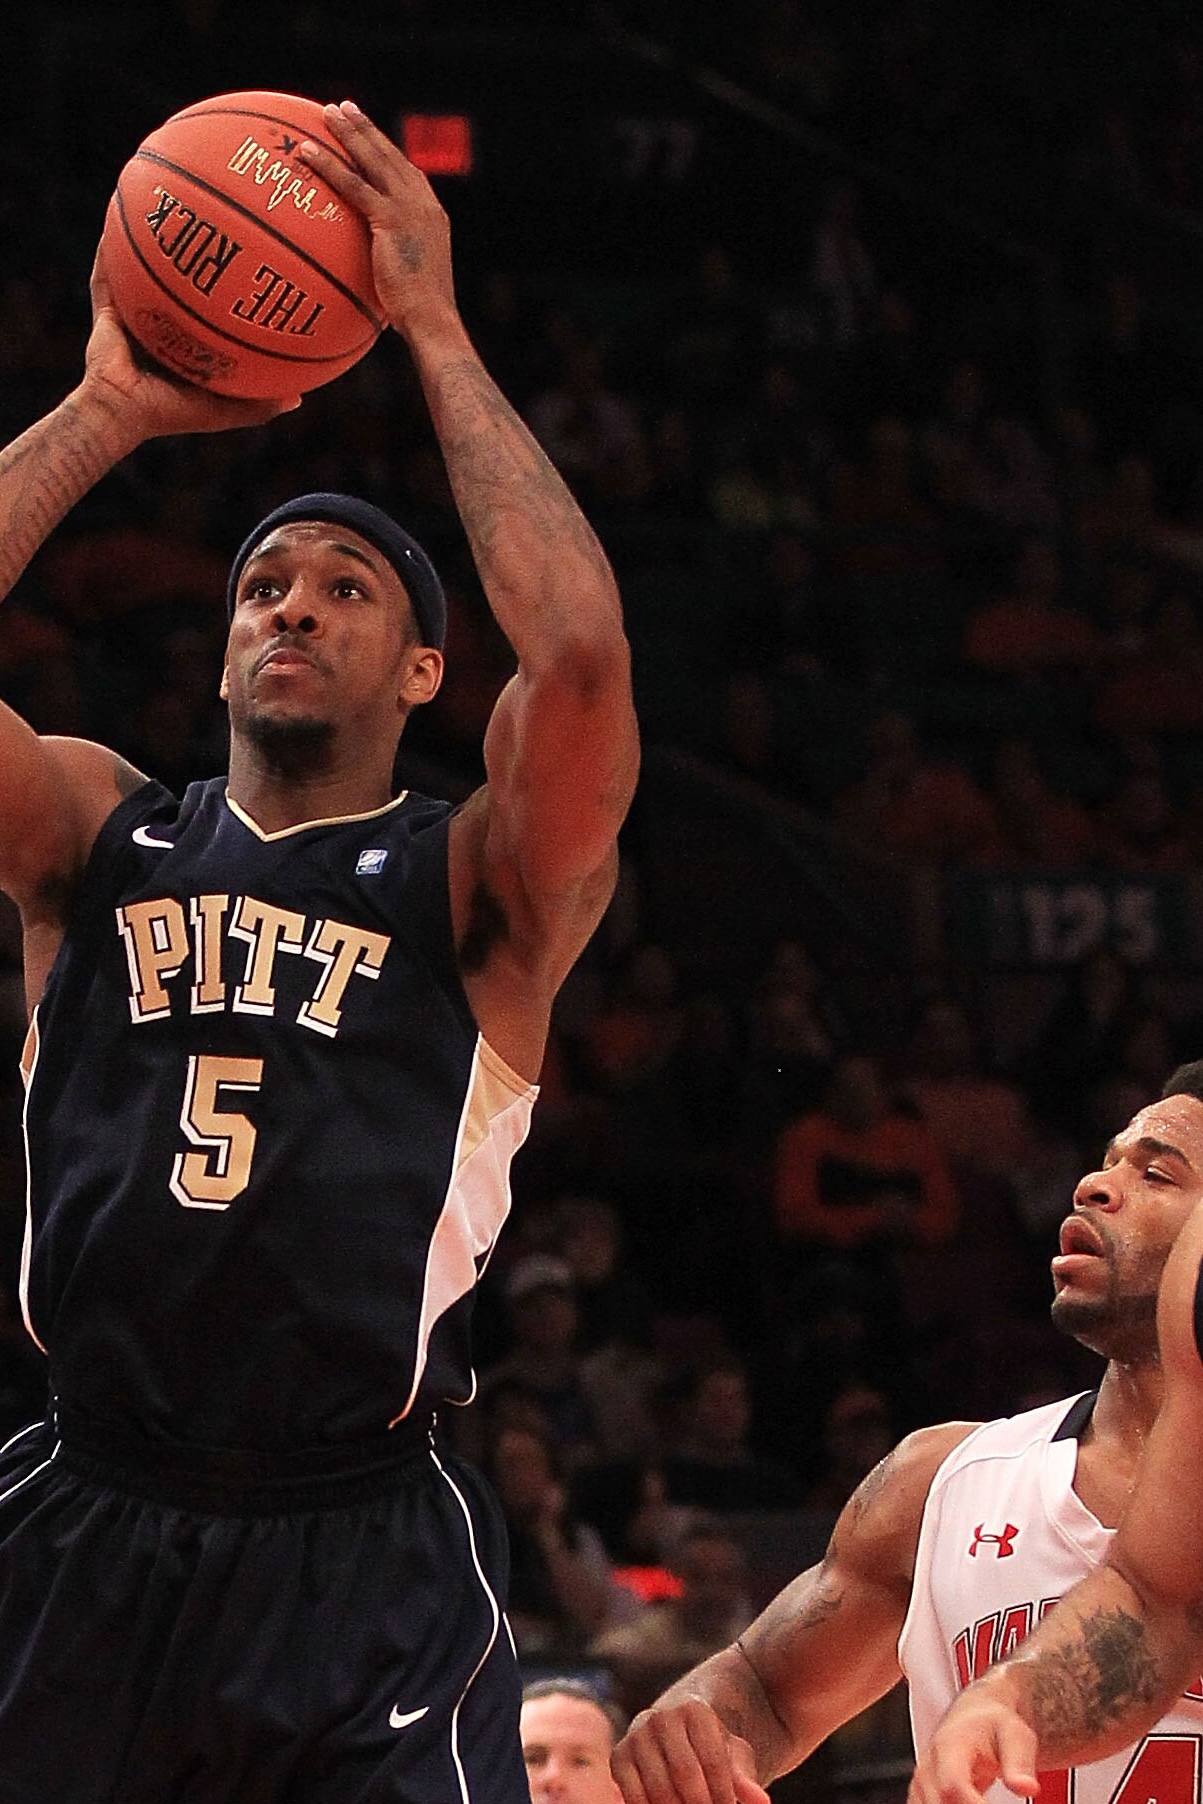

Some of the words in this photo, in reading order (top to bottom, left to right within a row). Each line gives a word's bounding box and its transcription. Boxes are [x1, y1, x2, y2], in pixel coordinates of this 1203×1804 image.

[146, 191, 243, 298] ROCK
[230, 264, 325, 338] THE
[115, 893, 391, 1038] PITT
[168, 1055, 265, 1211] 5
